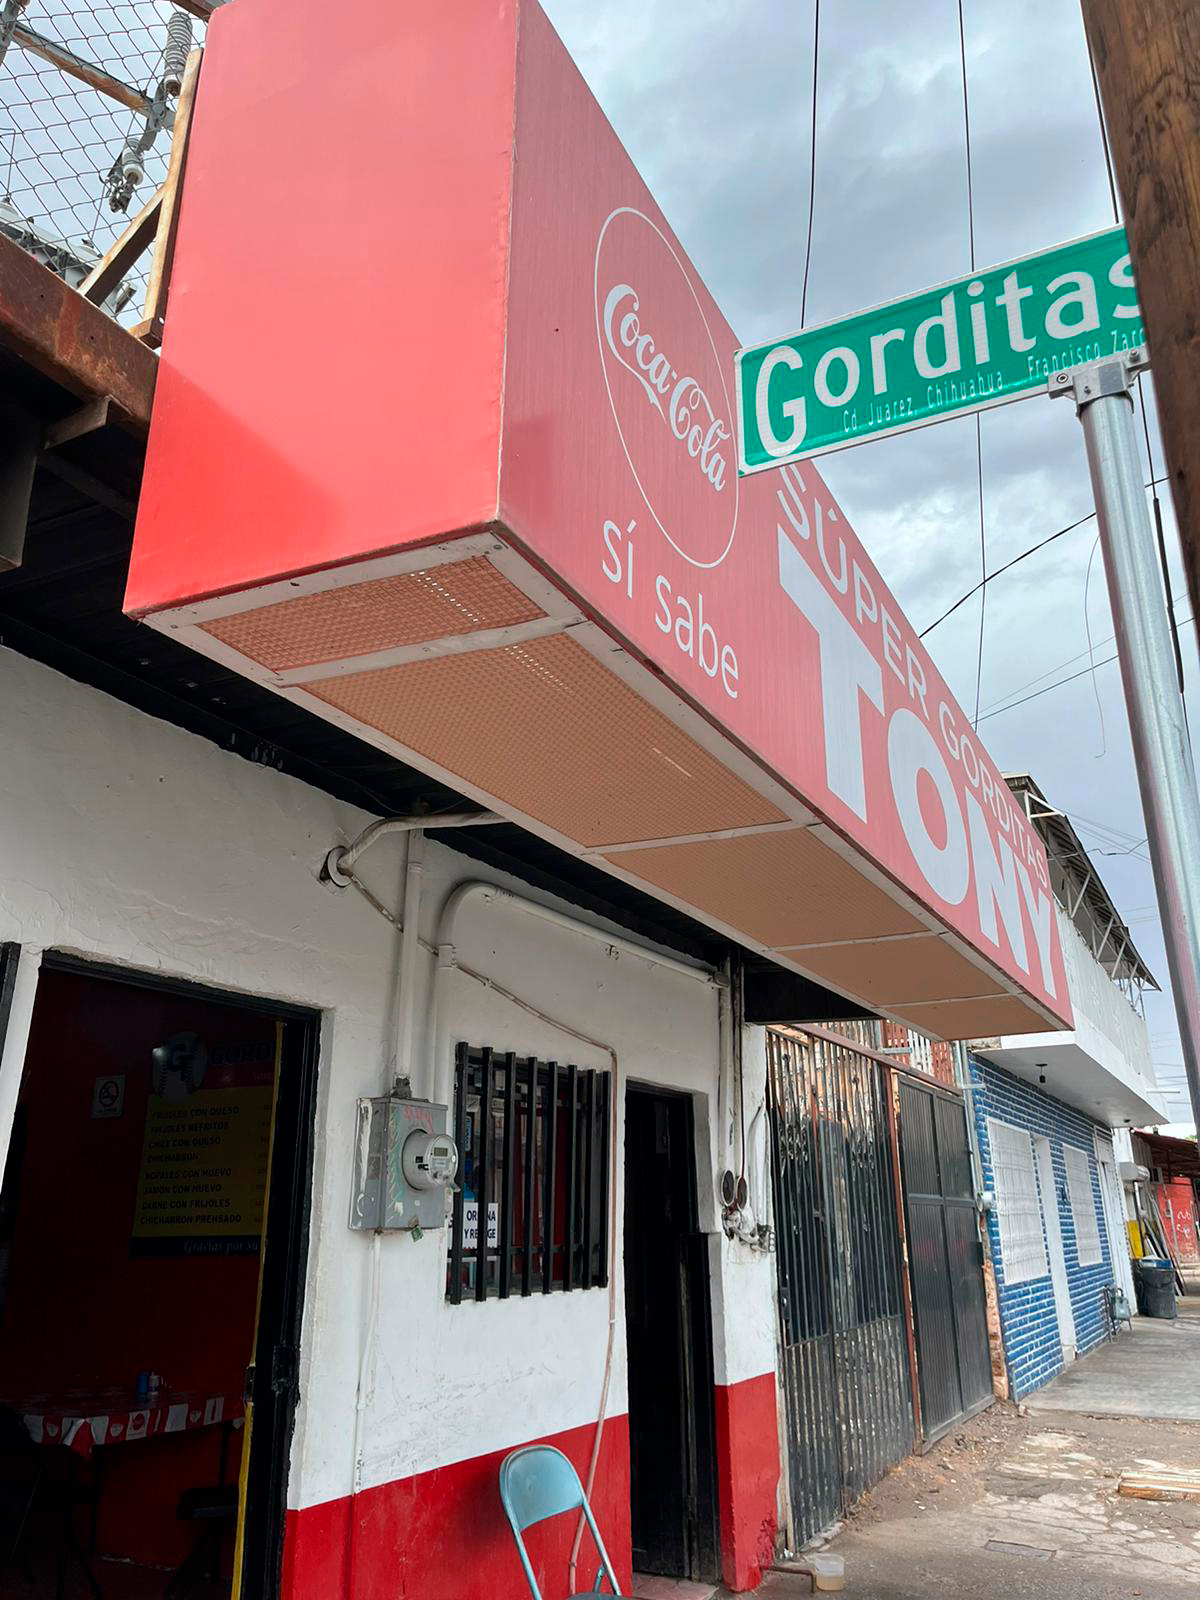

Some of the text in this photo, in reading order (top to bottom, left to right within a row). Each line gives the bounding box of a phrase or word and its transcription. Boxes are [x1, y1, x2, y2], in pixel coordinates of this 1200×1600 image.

[755, 250, 1142, 458] Gorditas
[926, 370, 1003, 410] Chihuahua
[1026, 341, 1101, 381] Francisco
[603, 283, 731, 491] Coca-Cola
[777, 522, 1058, 1001] TONY
[938, 700, 1049, 889] GORDITAS
[172, 1183, 190, 1193] CON
[191, 1183, 222, 1193] HUEVO
[202, 1167, 232, 1177] HUEVO
[169, 1199, 188, 1209] CON
[189, 1199, 231, 1208] FRIJOLES
[183, 1238, 224, 1255] Gracias
[225, 1240, 245, 1256] por
[463, 1228, 496, 1239] Y REGE
